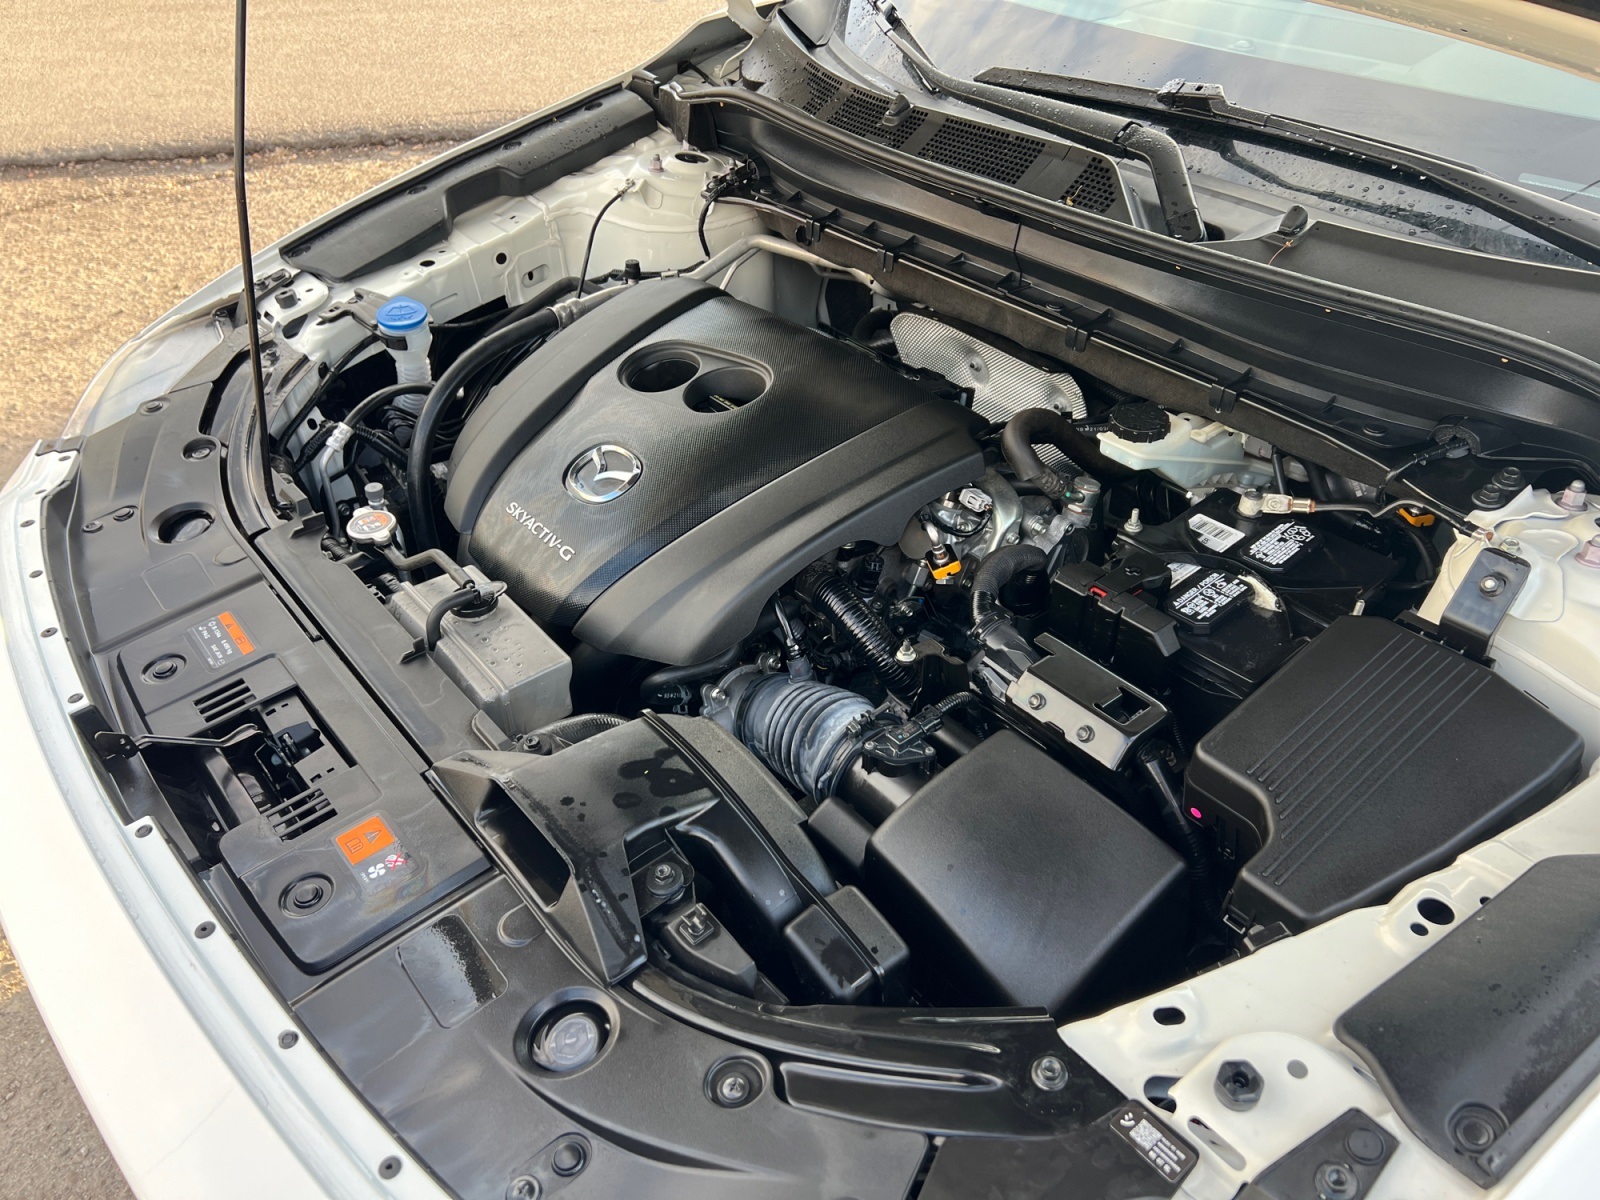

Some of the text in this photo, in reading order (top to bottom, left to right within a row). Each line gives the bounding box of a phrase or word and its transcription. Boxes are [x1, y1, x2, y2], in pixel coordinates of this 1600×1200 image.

[505, 501, 576, 562] SKYACTIV-G
[1176, 587, 1199, 603] DANGER
[1199, 572, 1220, 587] POISON
